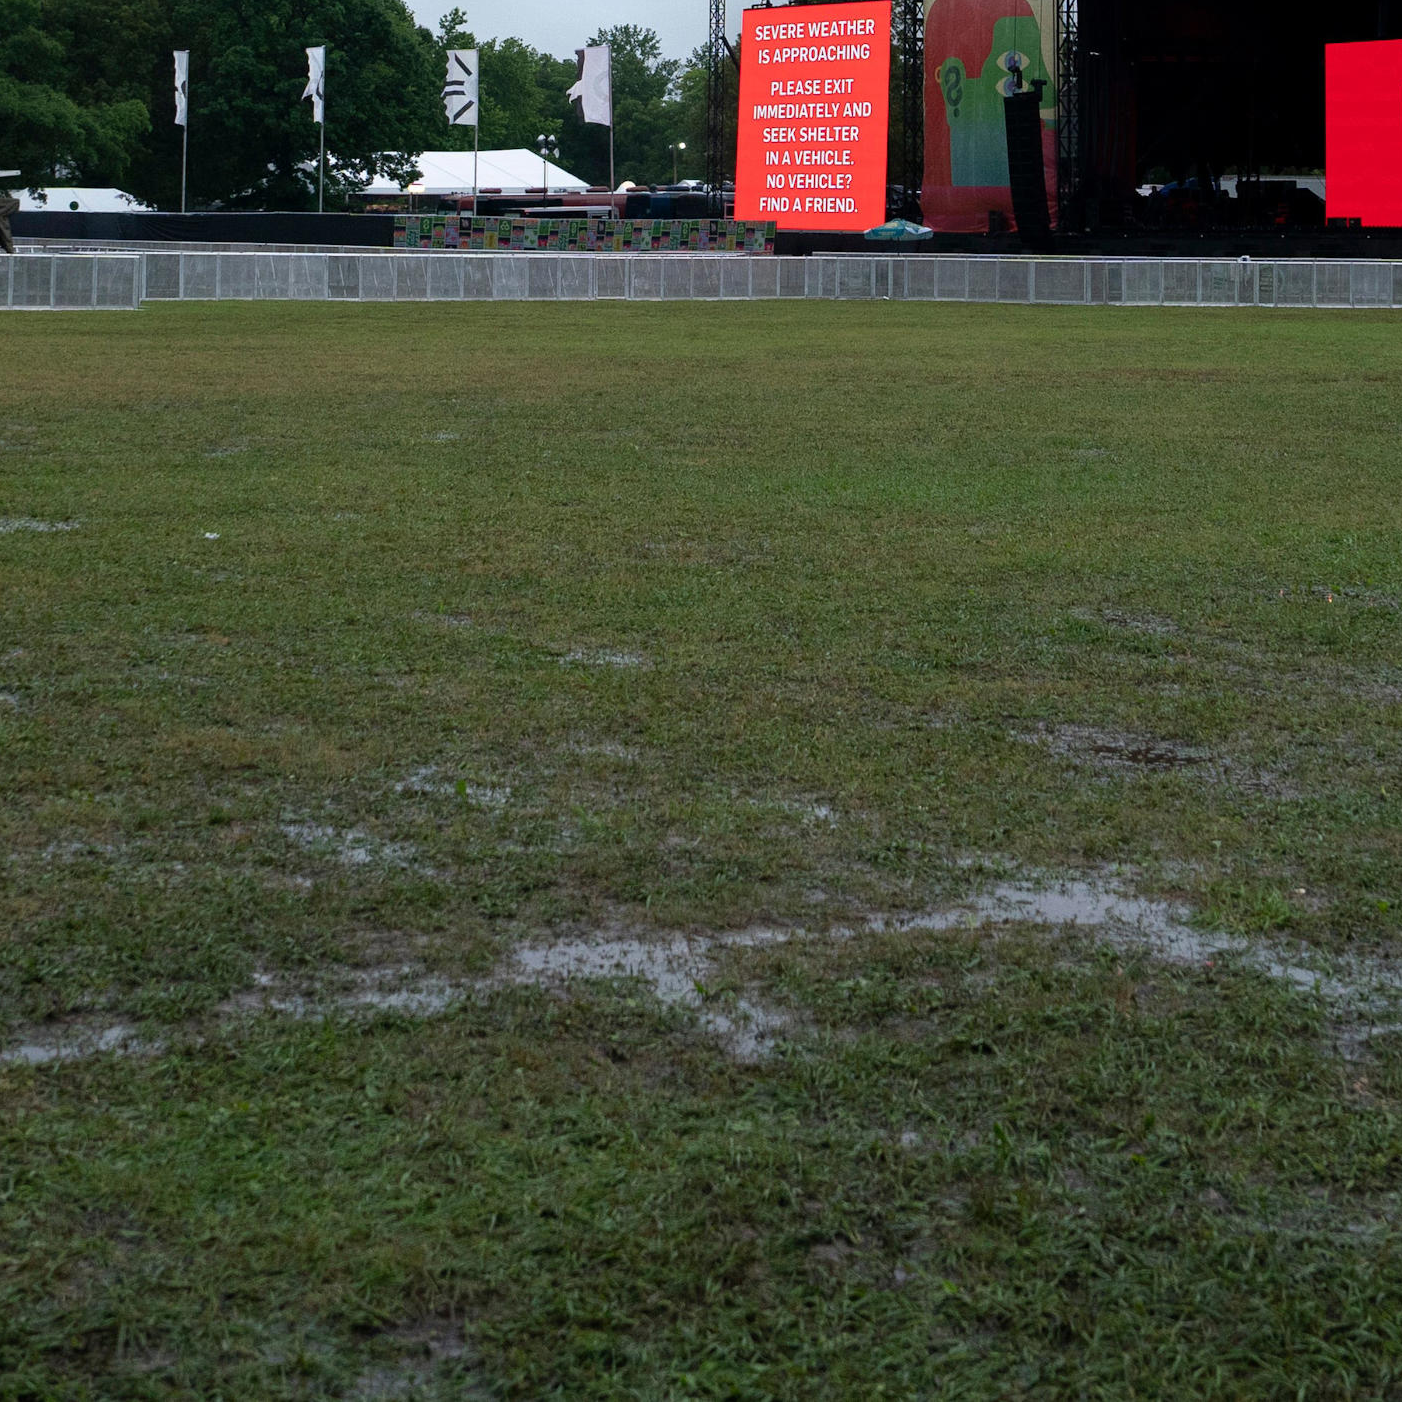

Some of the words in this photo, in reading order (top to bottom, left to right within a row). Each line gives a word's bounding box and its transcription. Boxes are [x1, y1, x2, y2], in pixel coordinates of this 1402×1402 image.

[755, 22, 805, 41] SEVERE
[808, 19, 875, 38] WEATHER
[758, 49, 771, 64] IS
[772, 43, 870, 63] APPROACHING
[770, 79, 821, 96] PLEASE
[824, 78, 854, 95] EXIT
[753, 102, 840, 120] IMMEDIATELY
[842, 101, 872, 117] AND
[763, 127, 796, 143] SEEK
[799, 126, 859, 142] SHELTER
[765, 150, 779, 165] IN
[781, 150, 791, 165] A
[794, 149, 855, 166] VEHICLE.
[766, 173, 785, 189] NO
[787, 173, 852, 189] VEHICLE?
[759, 197, 790, 212] FIND
[792, 197, 802, 212] A
[805, 197, 858, 213] FRIEND.
